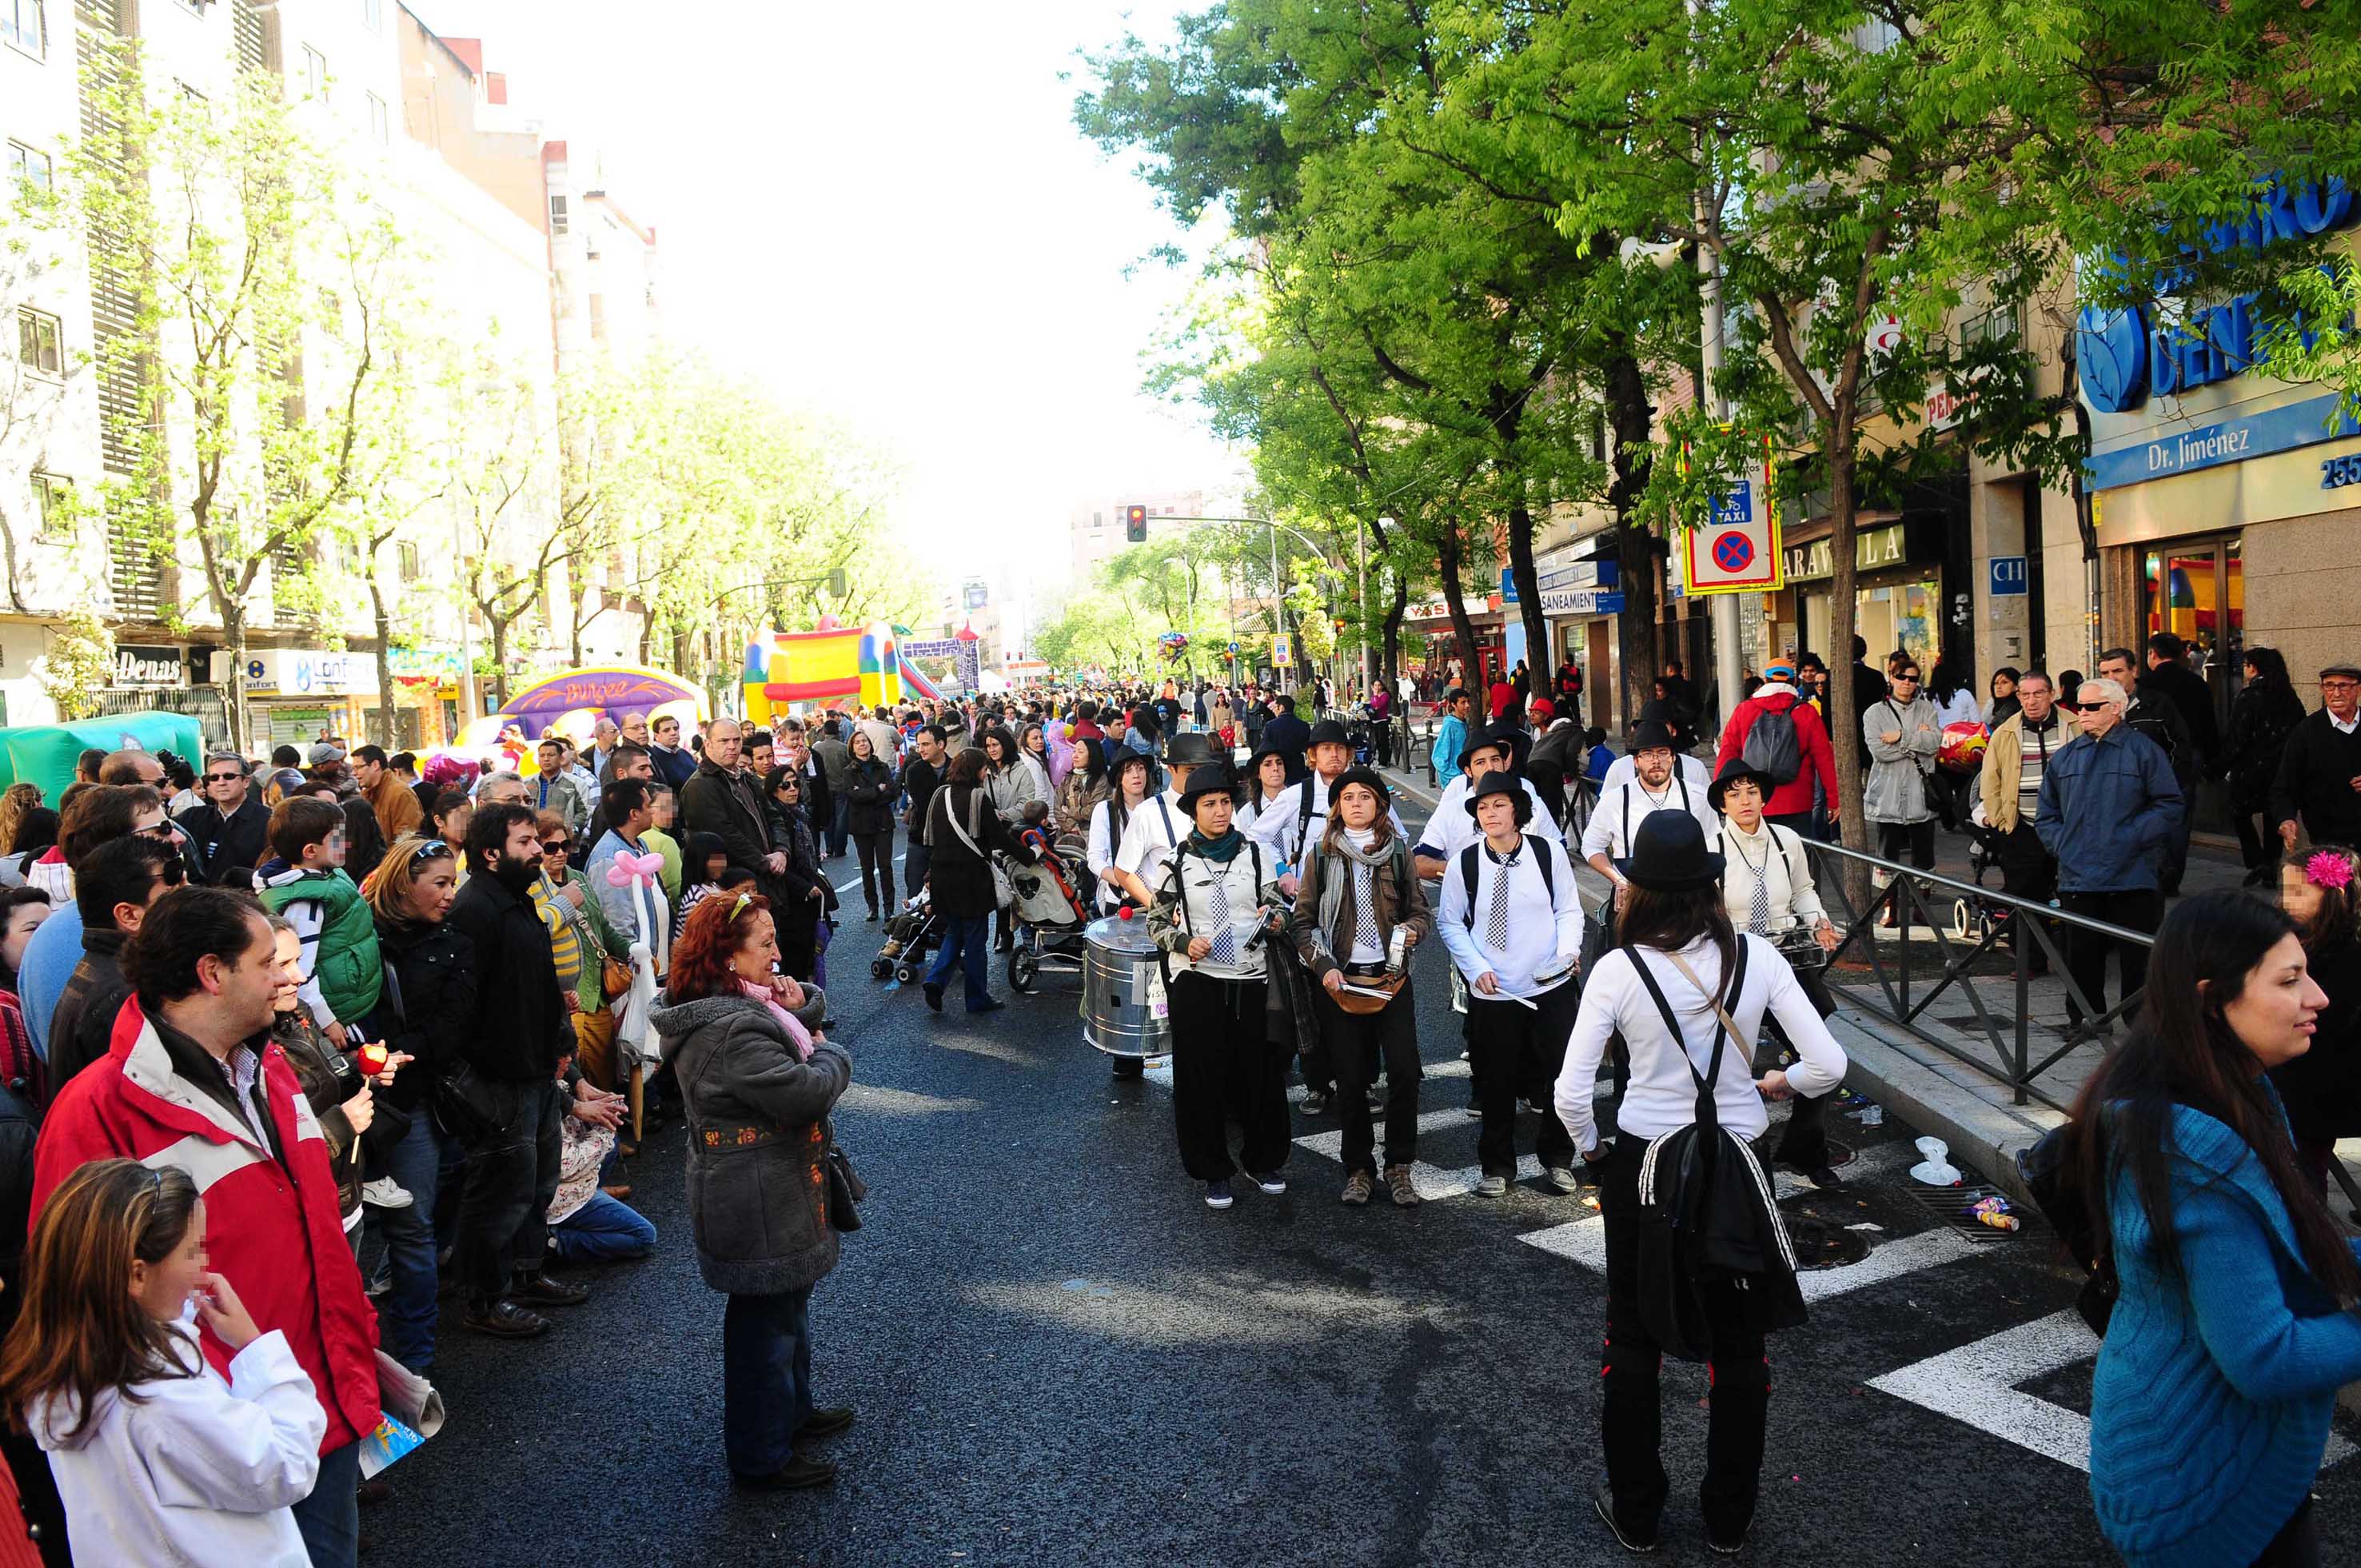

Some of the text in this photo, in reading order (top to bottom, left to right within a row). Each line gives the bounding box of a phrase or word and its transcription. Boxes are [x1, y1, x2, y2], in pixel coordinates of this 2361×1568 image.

[2148, 428, 2250, 471] Dr. Jiménez
[1717, 511, 1746, 524] TAXI
[1541, 591, 1596, 610] SANEAMIENT
